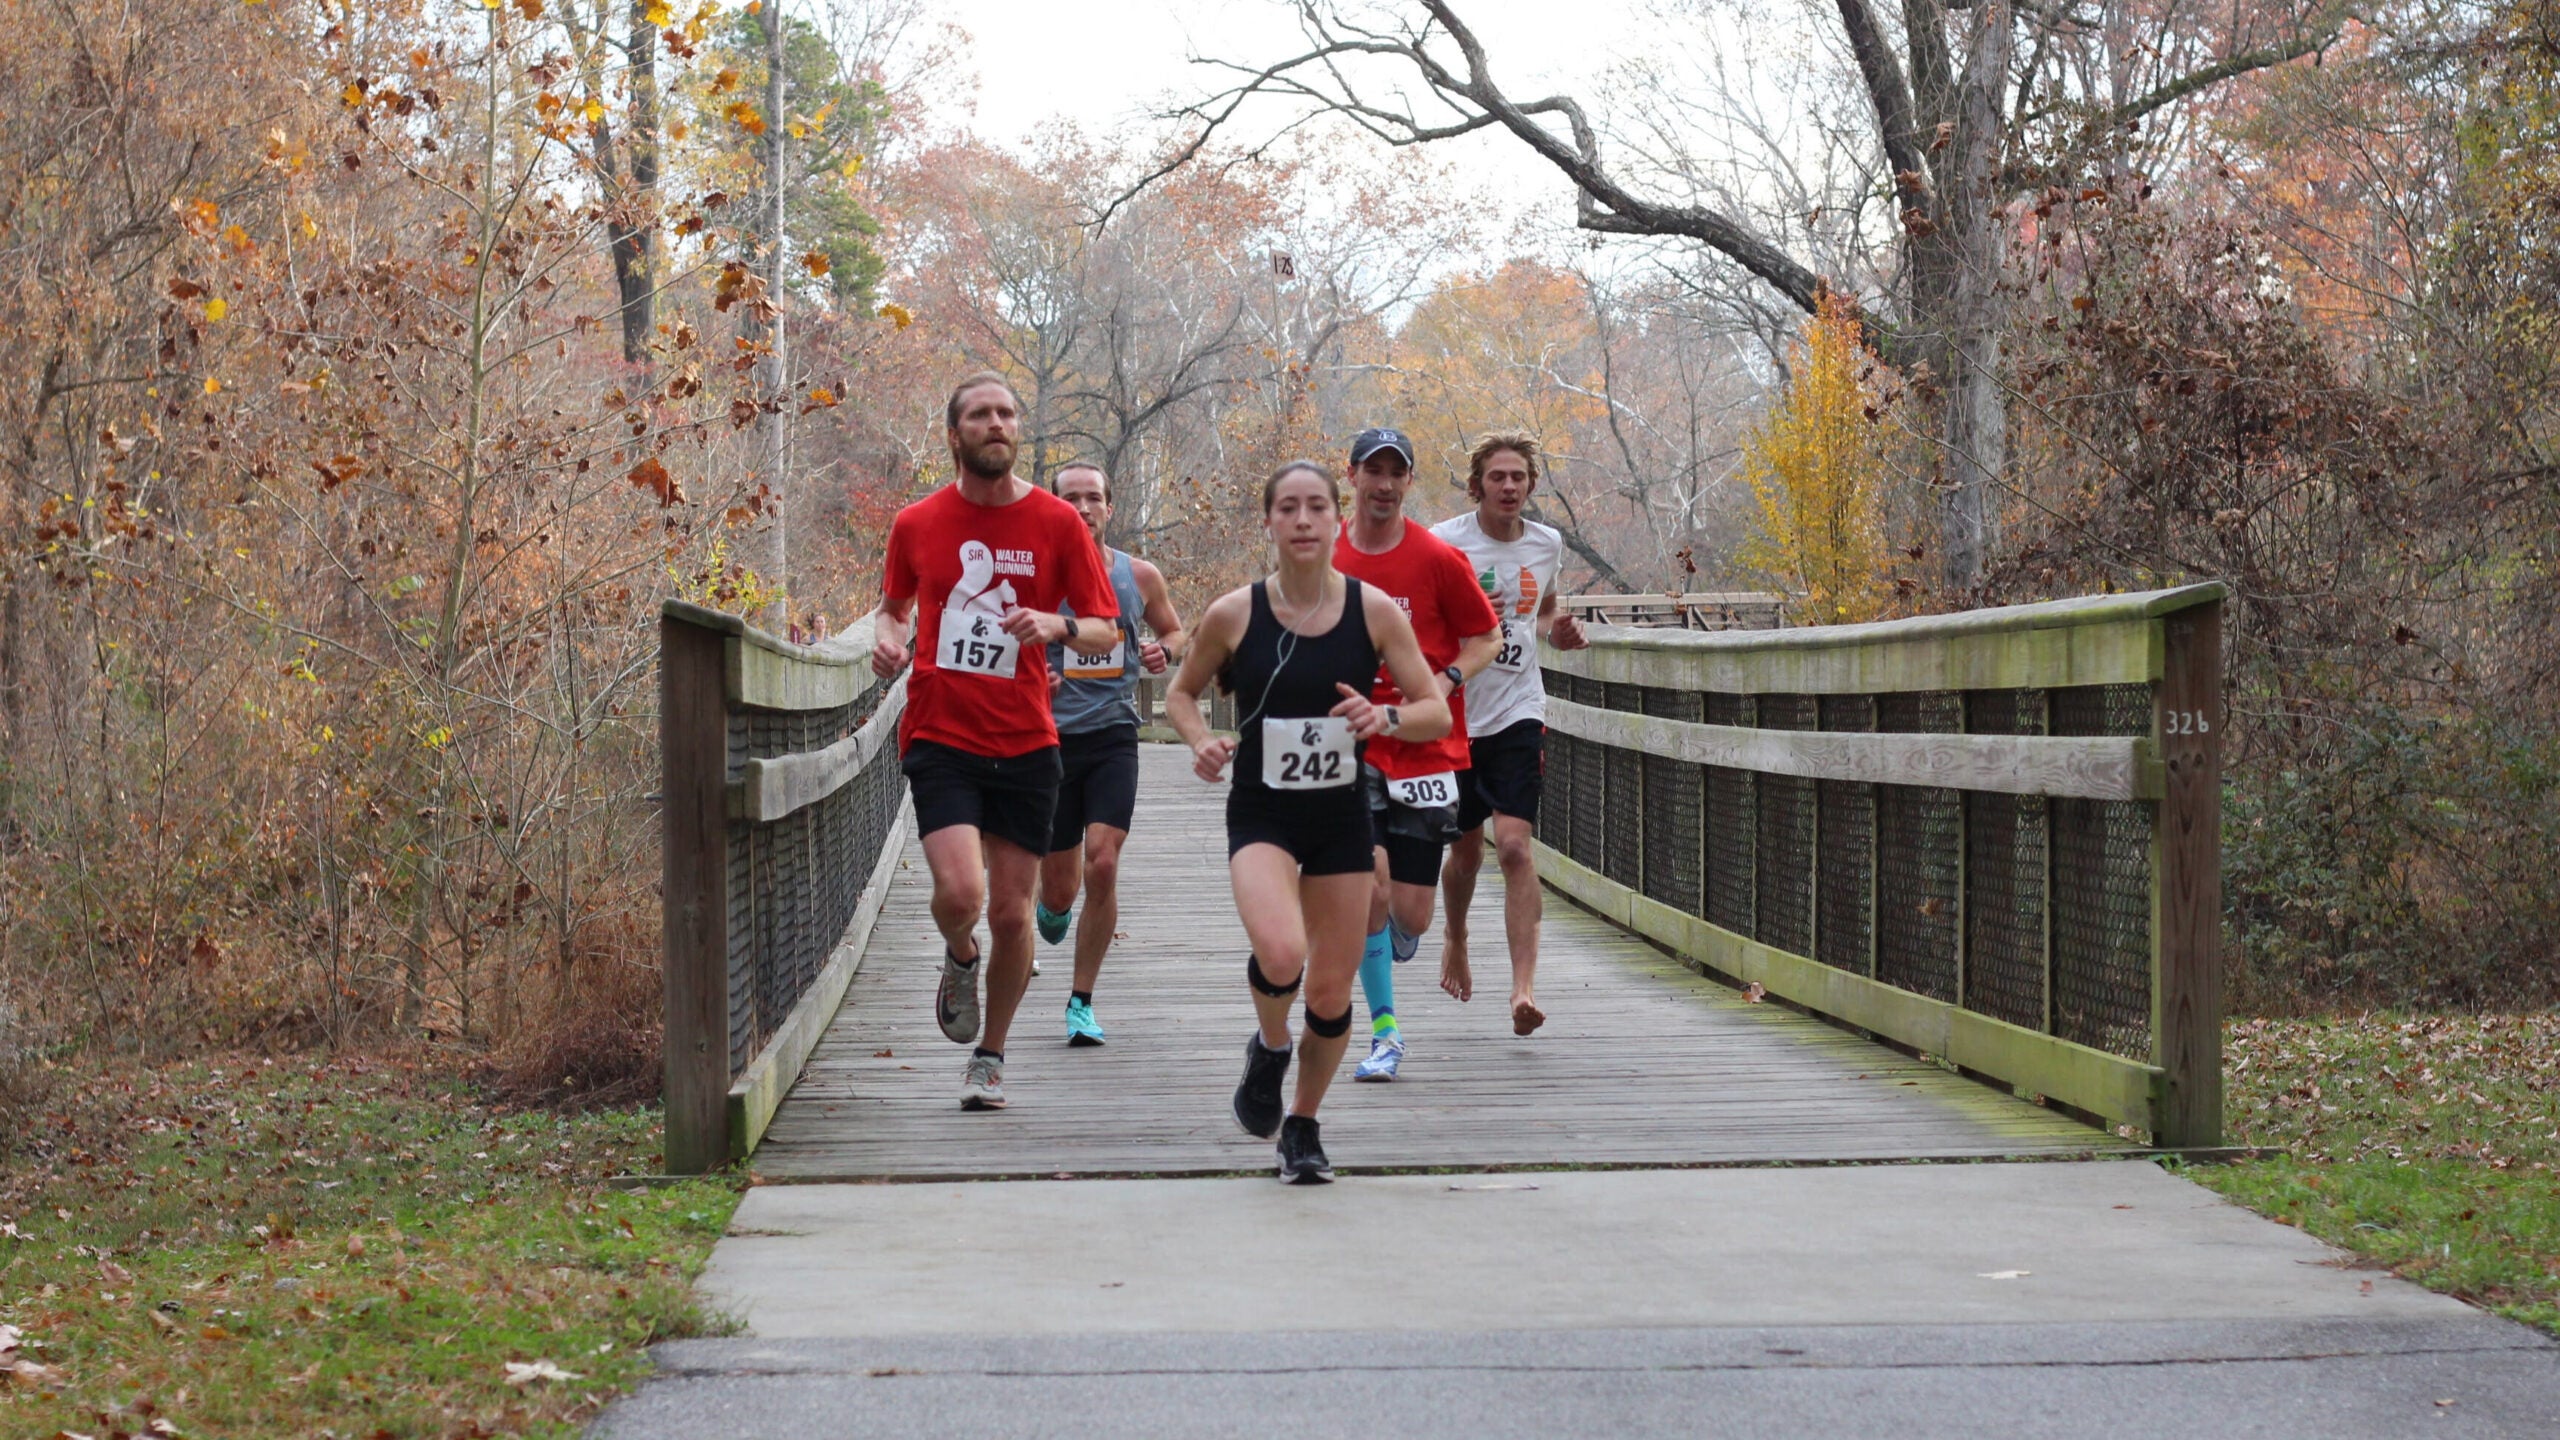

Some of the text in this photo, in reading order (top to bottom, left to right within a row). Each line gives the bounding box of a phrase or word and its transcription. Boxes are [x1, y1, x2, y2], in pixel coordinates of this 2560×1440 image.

[968, 549, 1033, 563] SIR WALTER
[994, 562, 1036, 577] RUNNING
[952, 639, 1005, 669] 157
[1280, 750, 1341, 782] 242
[1401, 779, 1448, 804] 303
